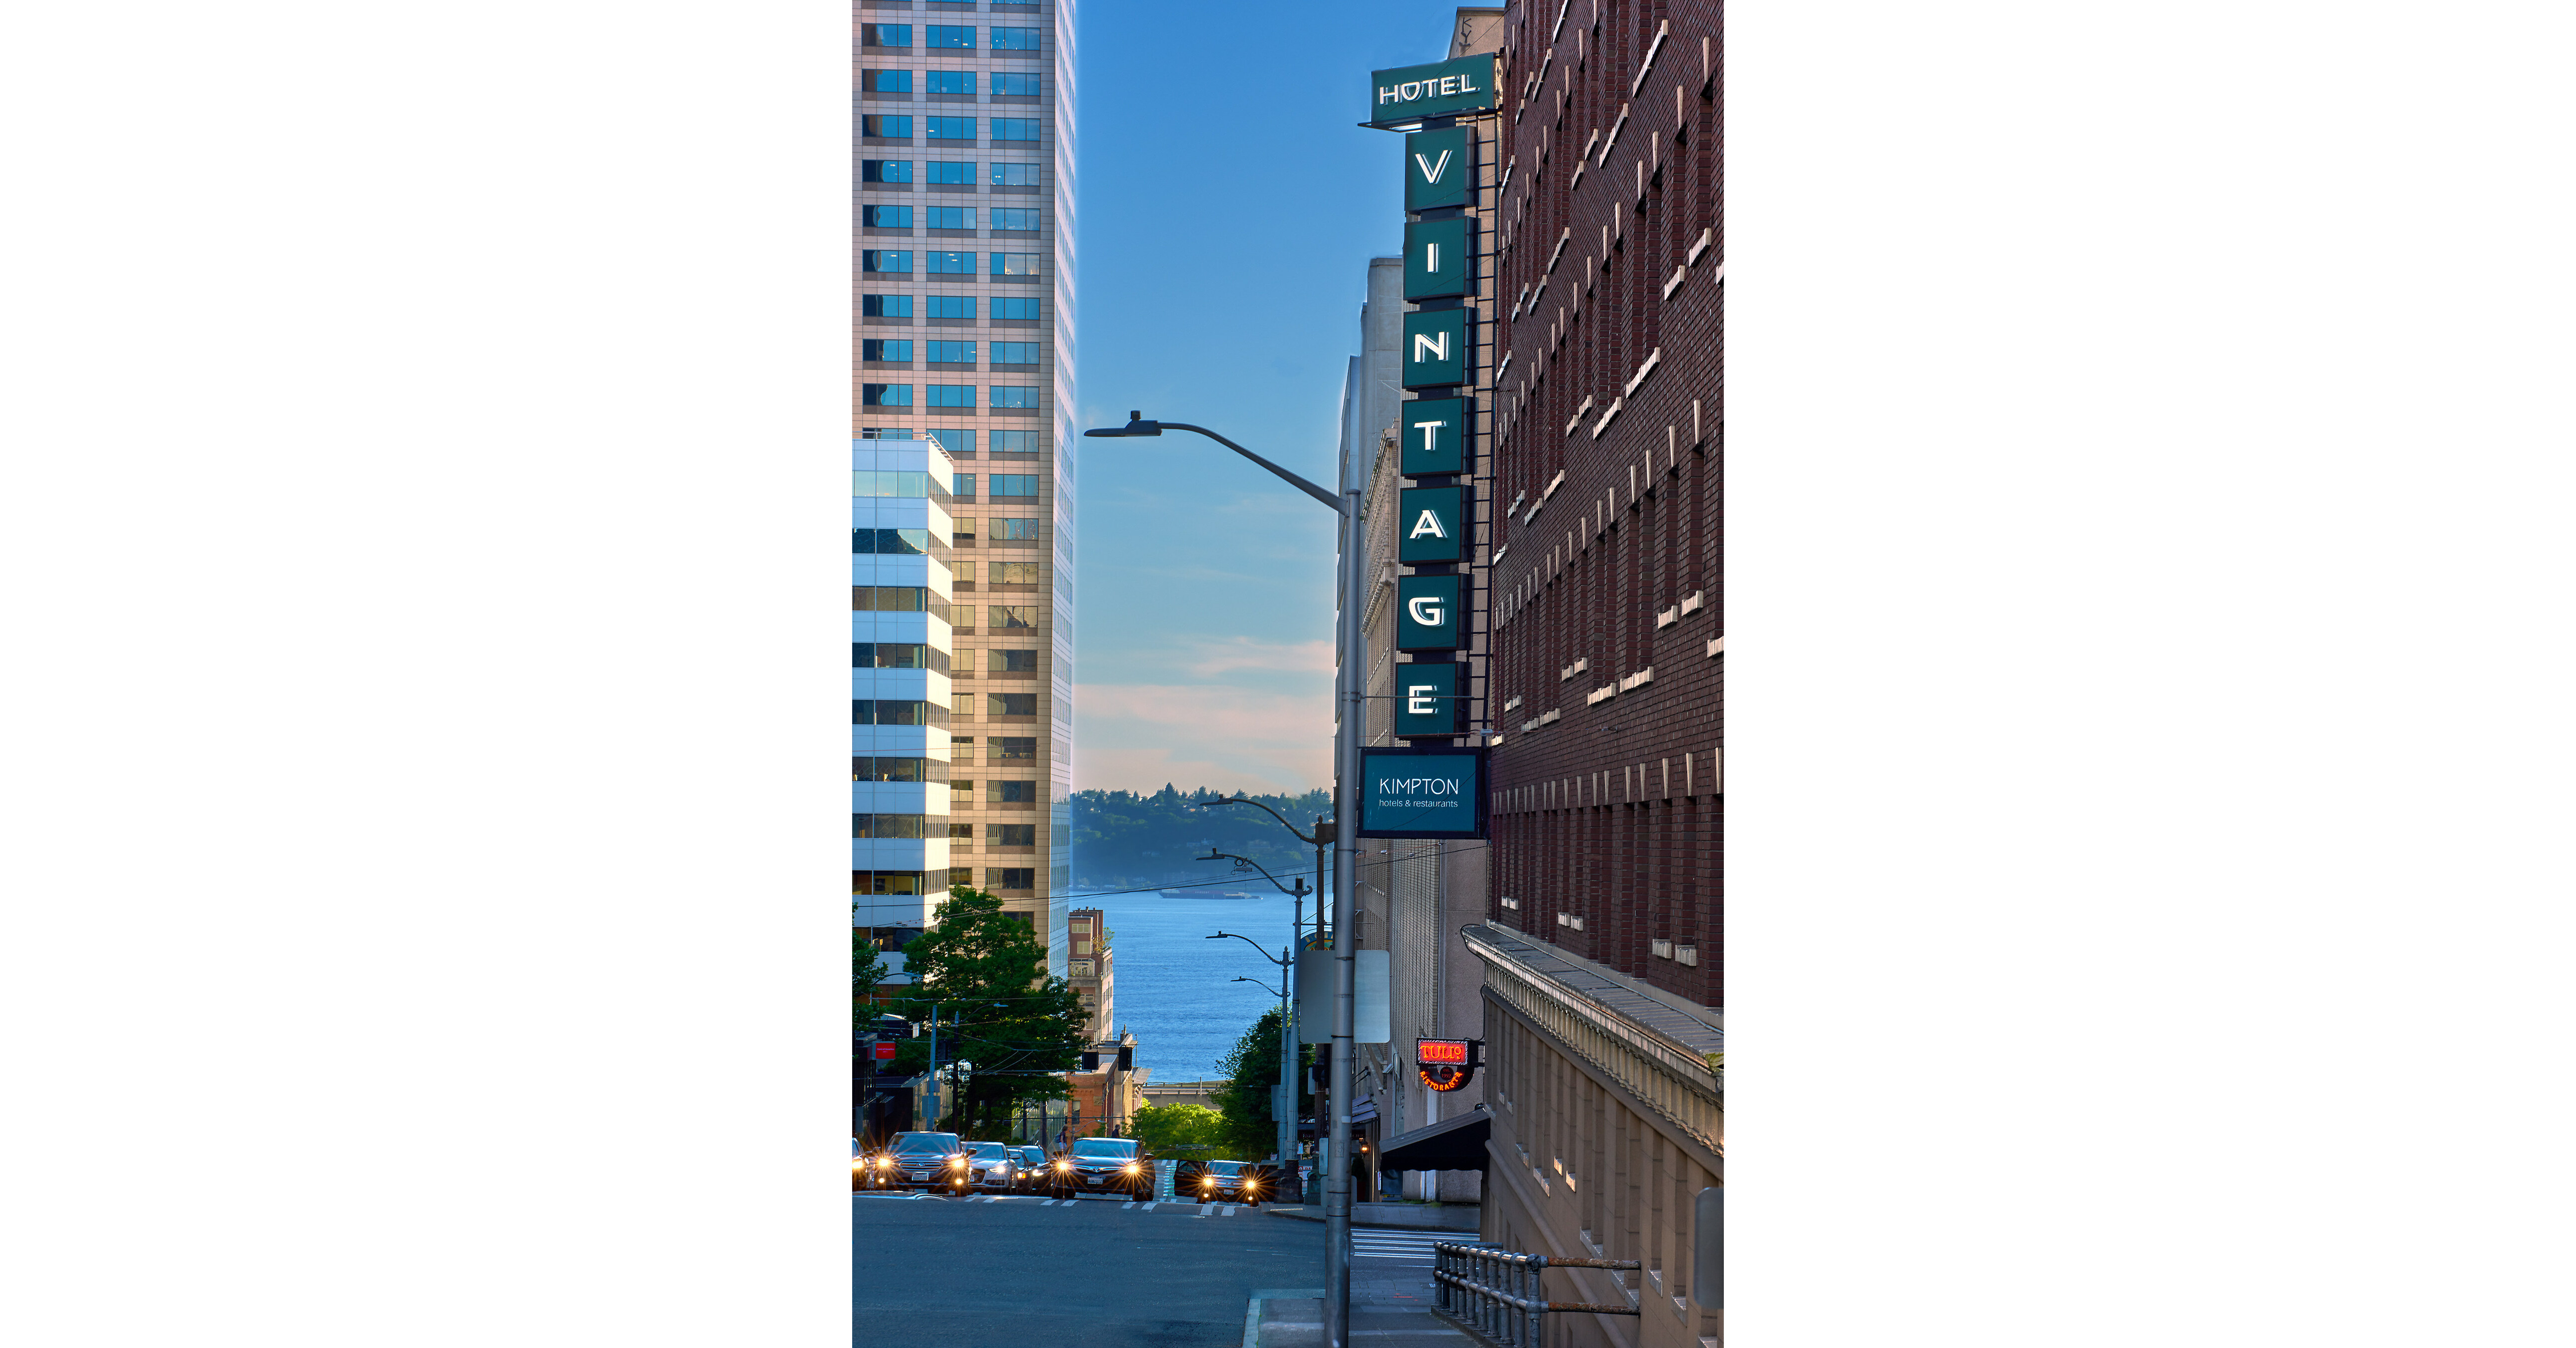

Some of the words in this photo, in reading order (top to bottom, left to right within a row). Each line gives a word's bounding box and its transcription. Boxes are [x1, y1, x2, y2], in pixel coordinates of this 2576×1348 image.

[1380, 74, 1480, 105] HOTEL
[1408, 150, 1451, 714] VINTAGE
[1379, 778, 1459, 794] KIMPTON
[1420, 1045, 1461, 1059] TULIO
[1420, 1071, 1463, 1091] RISTORANTE
